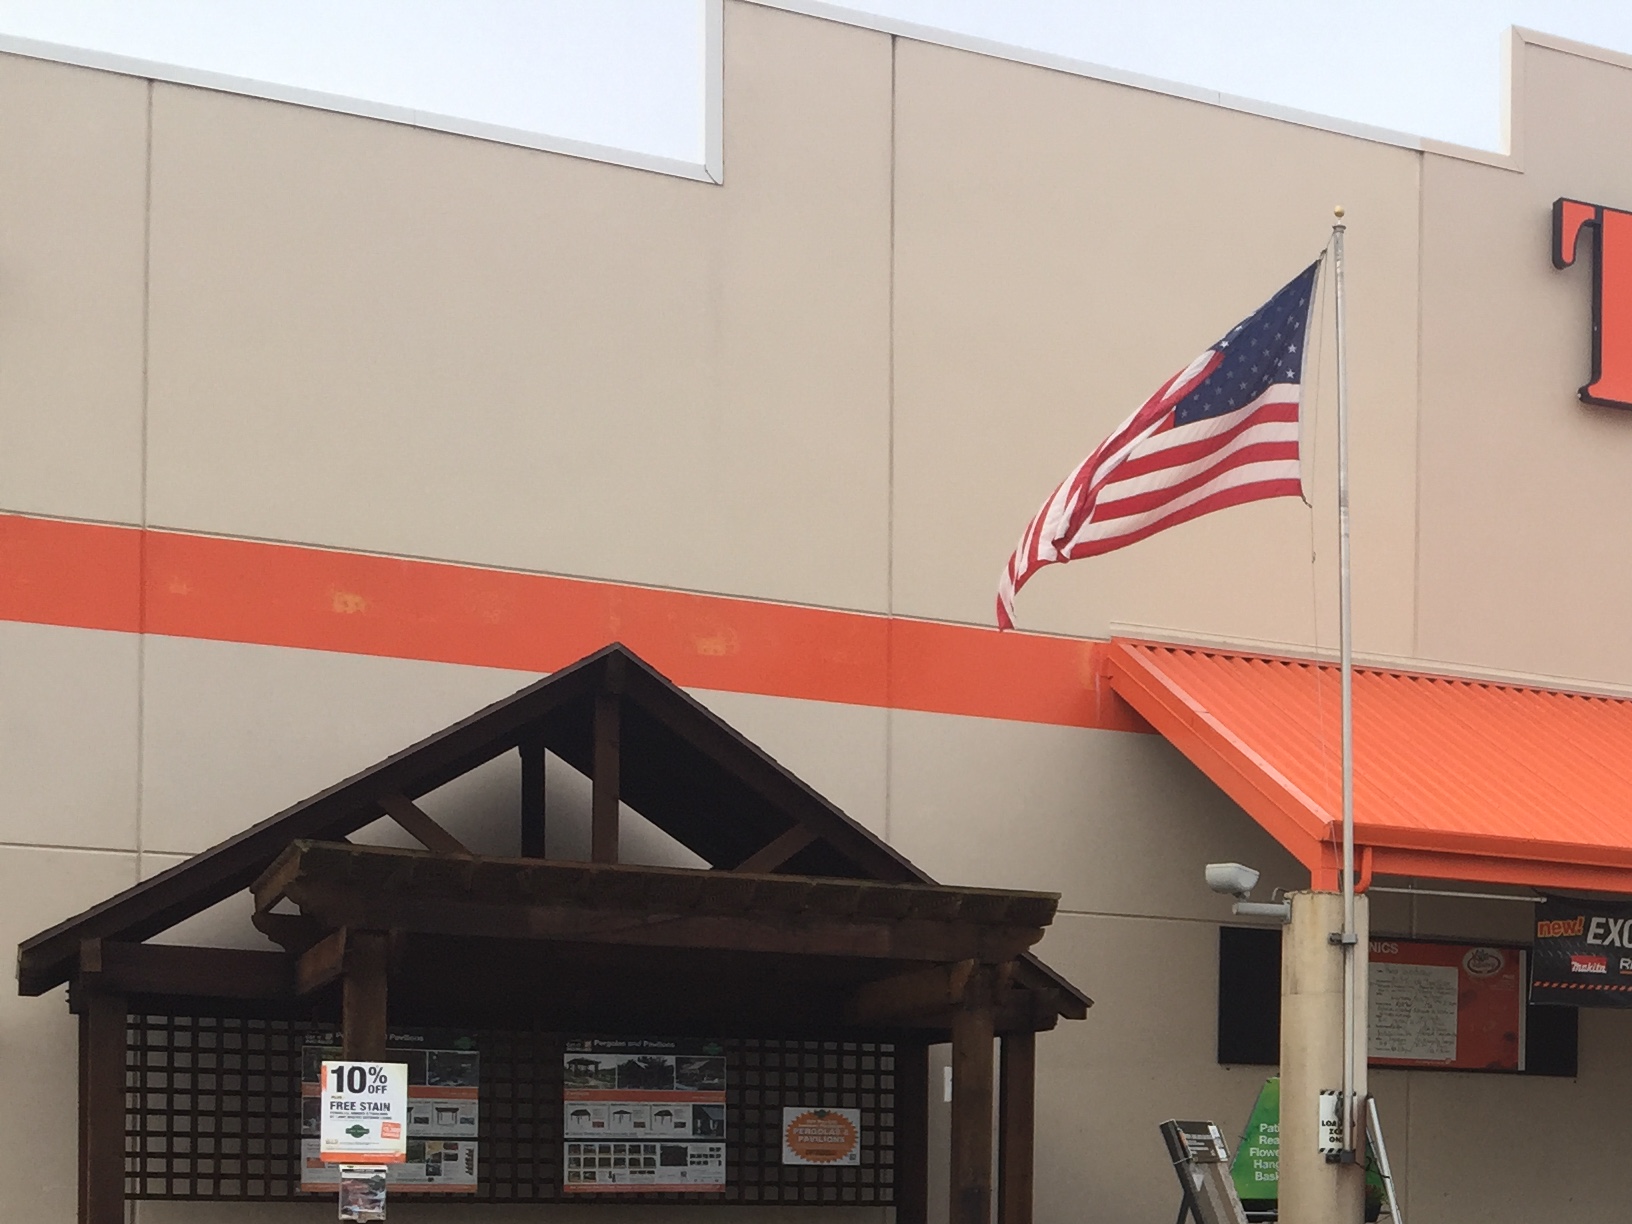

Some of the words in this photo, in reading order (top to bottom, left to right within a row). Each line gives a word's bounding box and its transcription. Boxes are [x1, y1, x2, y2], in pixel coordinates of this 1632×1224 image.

[1537, 916, 1584, 938] new!
[1369, 941, 1399, 955] NICS
[331, 1065, 388, 1094] 10%
[368, 1084, 388, 1094] OFF
[330, 1101, 356, 1111] FREE
[360, 1102, 391, 1111] STAIN
[1259, 1135, 1279, 1145] Rea
